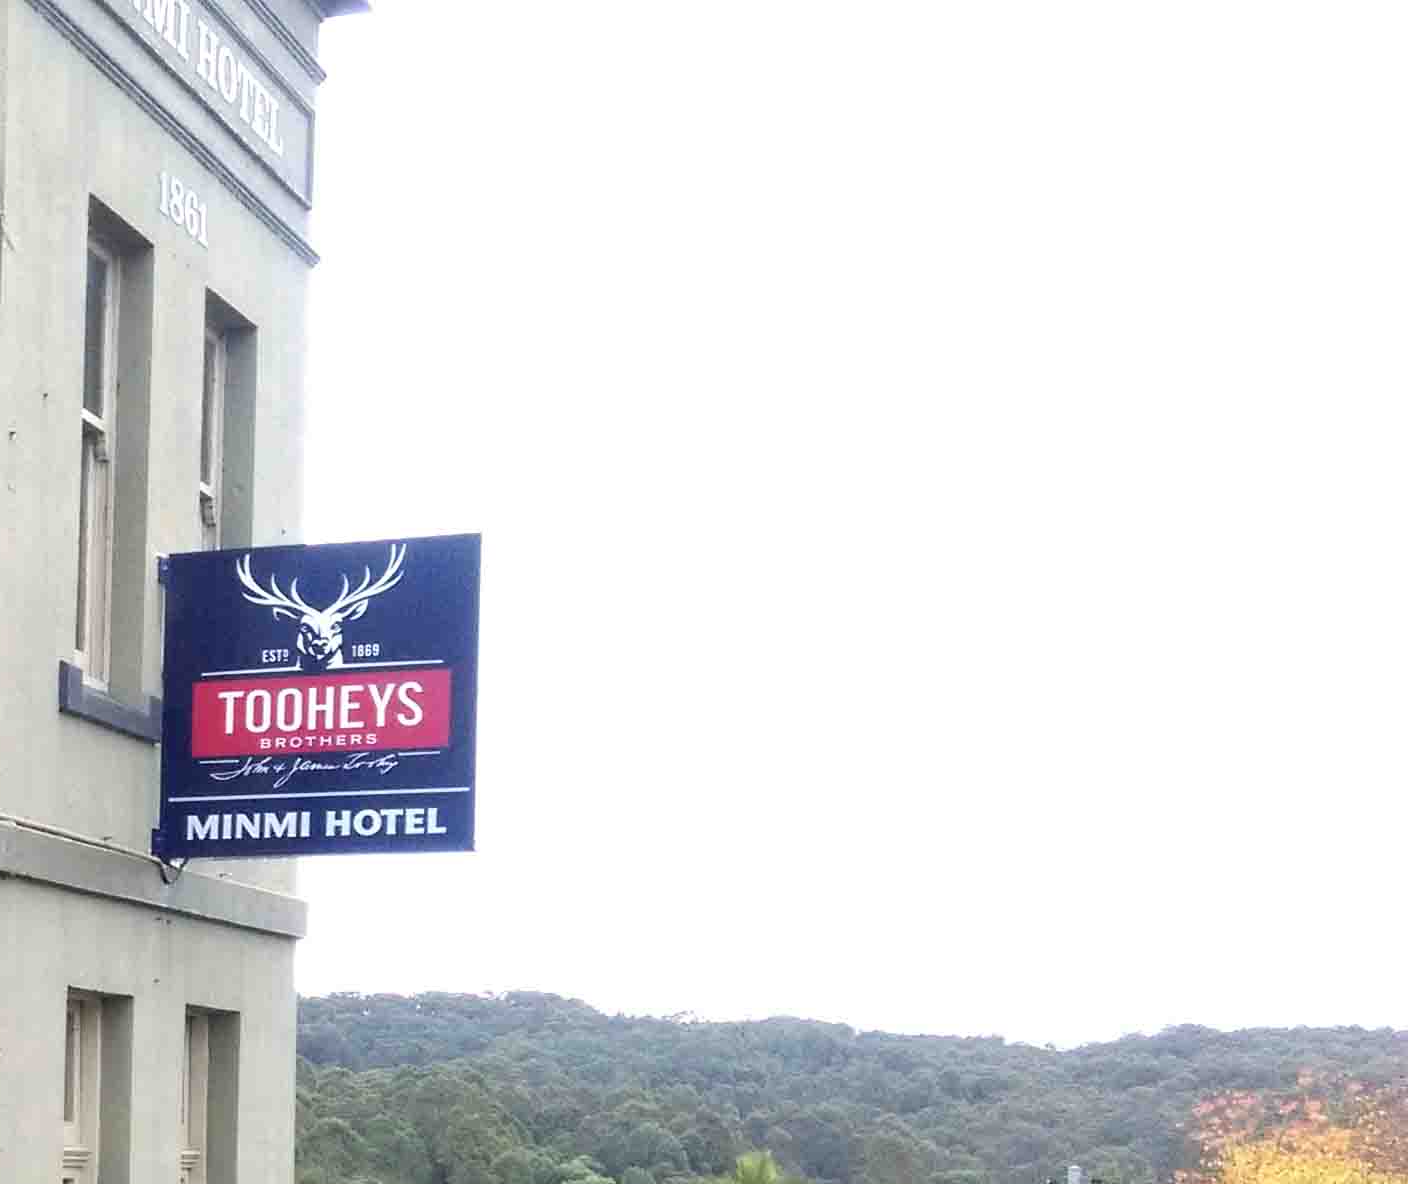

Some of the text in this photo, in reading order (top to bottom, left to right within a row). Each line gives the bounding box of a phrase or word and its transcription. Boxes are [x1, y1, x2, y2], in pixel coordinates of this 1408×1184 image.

[196, 18, 284, 157] HOTEL
[160, 171, 208, 248] 1861
[218, 681, 424, 735] TOOHEYS
[259, 733, 378, 749] BROTHERS
[186, 807, 447, 841] MINMI HOTEL
